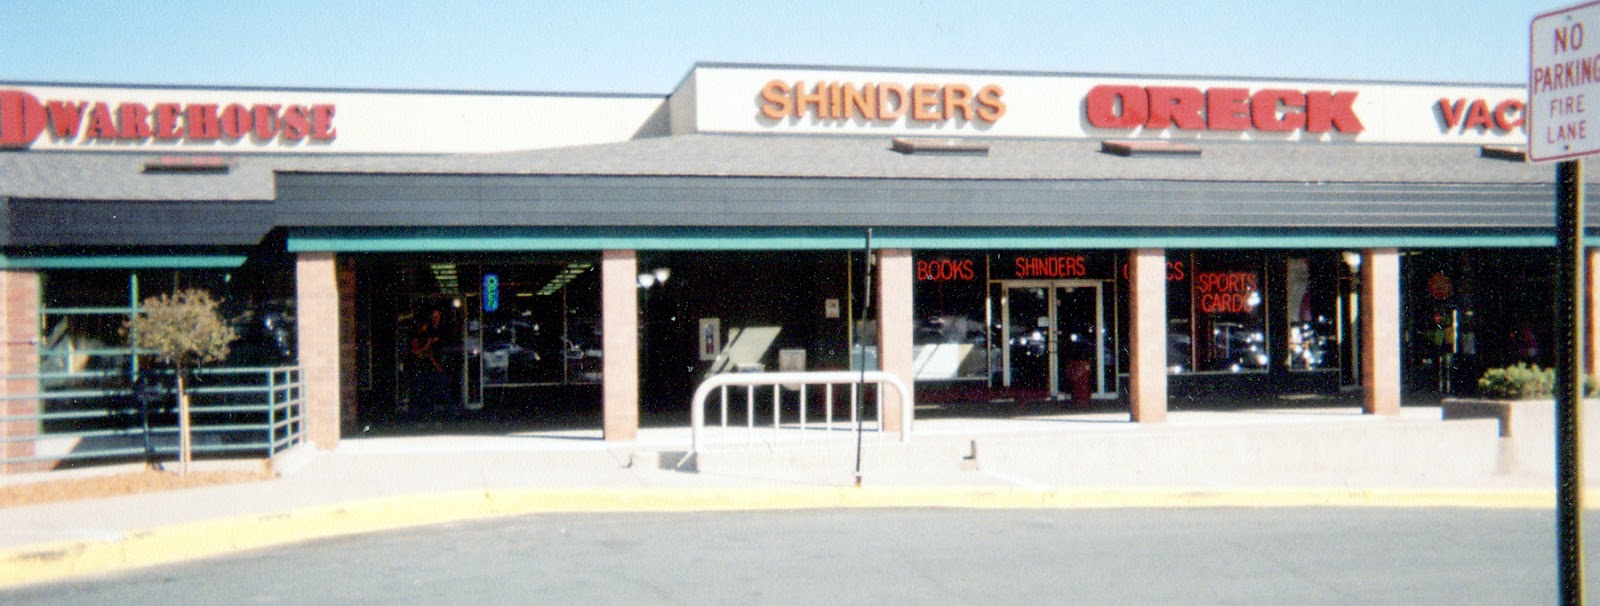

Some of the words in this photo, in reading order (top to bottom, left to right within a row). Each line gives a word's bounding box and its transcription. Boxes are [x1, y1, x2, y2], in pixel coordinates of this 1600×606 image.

[1554, 22, 1584, 54] NO
[1534, 54, 1600, 95] PARKING
[761, 80, 1006, 122] SHINDERS
[1086, 84, 1365, 134] ORECK
[1551, 94, 1585, 118] FIRE
[46, 100, 336, 140] WAREHOUSE
[1547, 120, 1587, 144] LANE
[916, 260, 975, 281] BOOKS
[1015, 256, 1086, 277] SHINDERS
[1199, 272, 1258, 293] SPORTS
[487, 276, 498, 310] OPEN
